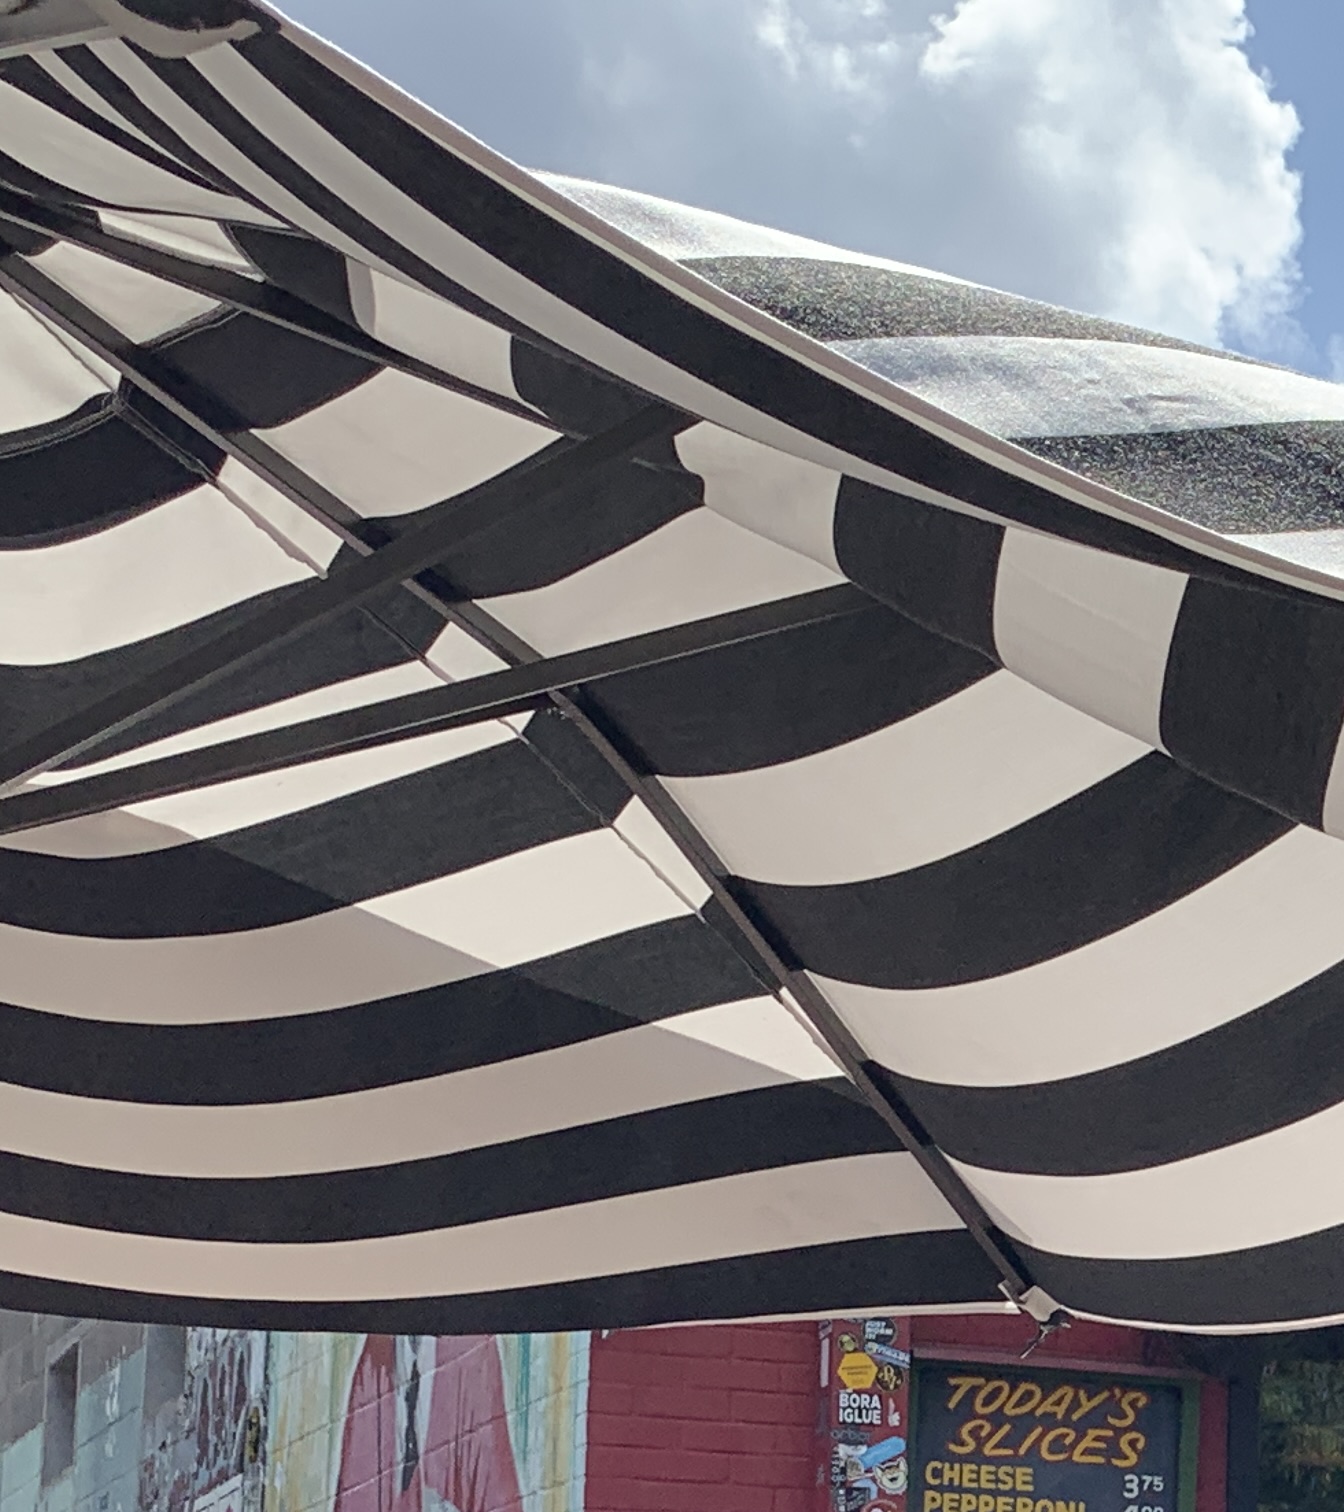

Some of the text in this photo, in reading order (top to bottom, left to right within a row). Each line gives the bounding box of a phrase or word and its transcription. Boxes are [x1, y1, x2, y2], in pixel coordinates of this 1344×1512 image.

[839, 1393, 882, 1409] BORA
[839, 1408, 882, 1425] IGLUE
[947, 1376, 1148, 1428] TODAY'S
[948, 1419, 1146, 1469] SLICES
[925, 1461, 1034, 1492] CHEESE
